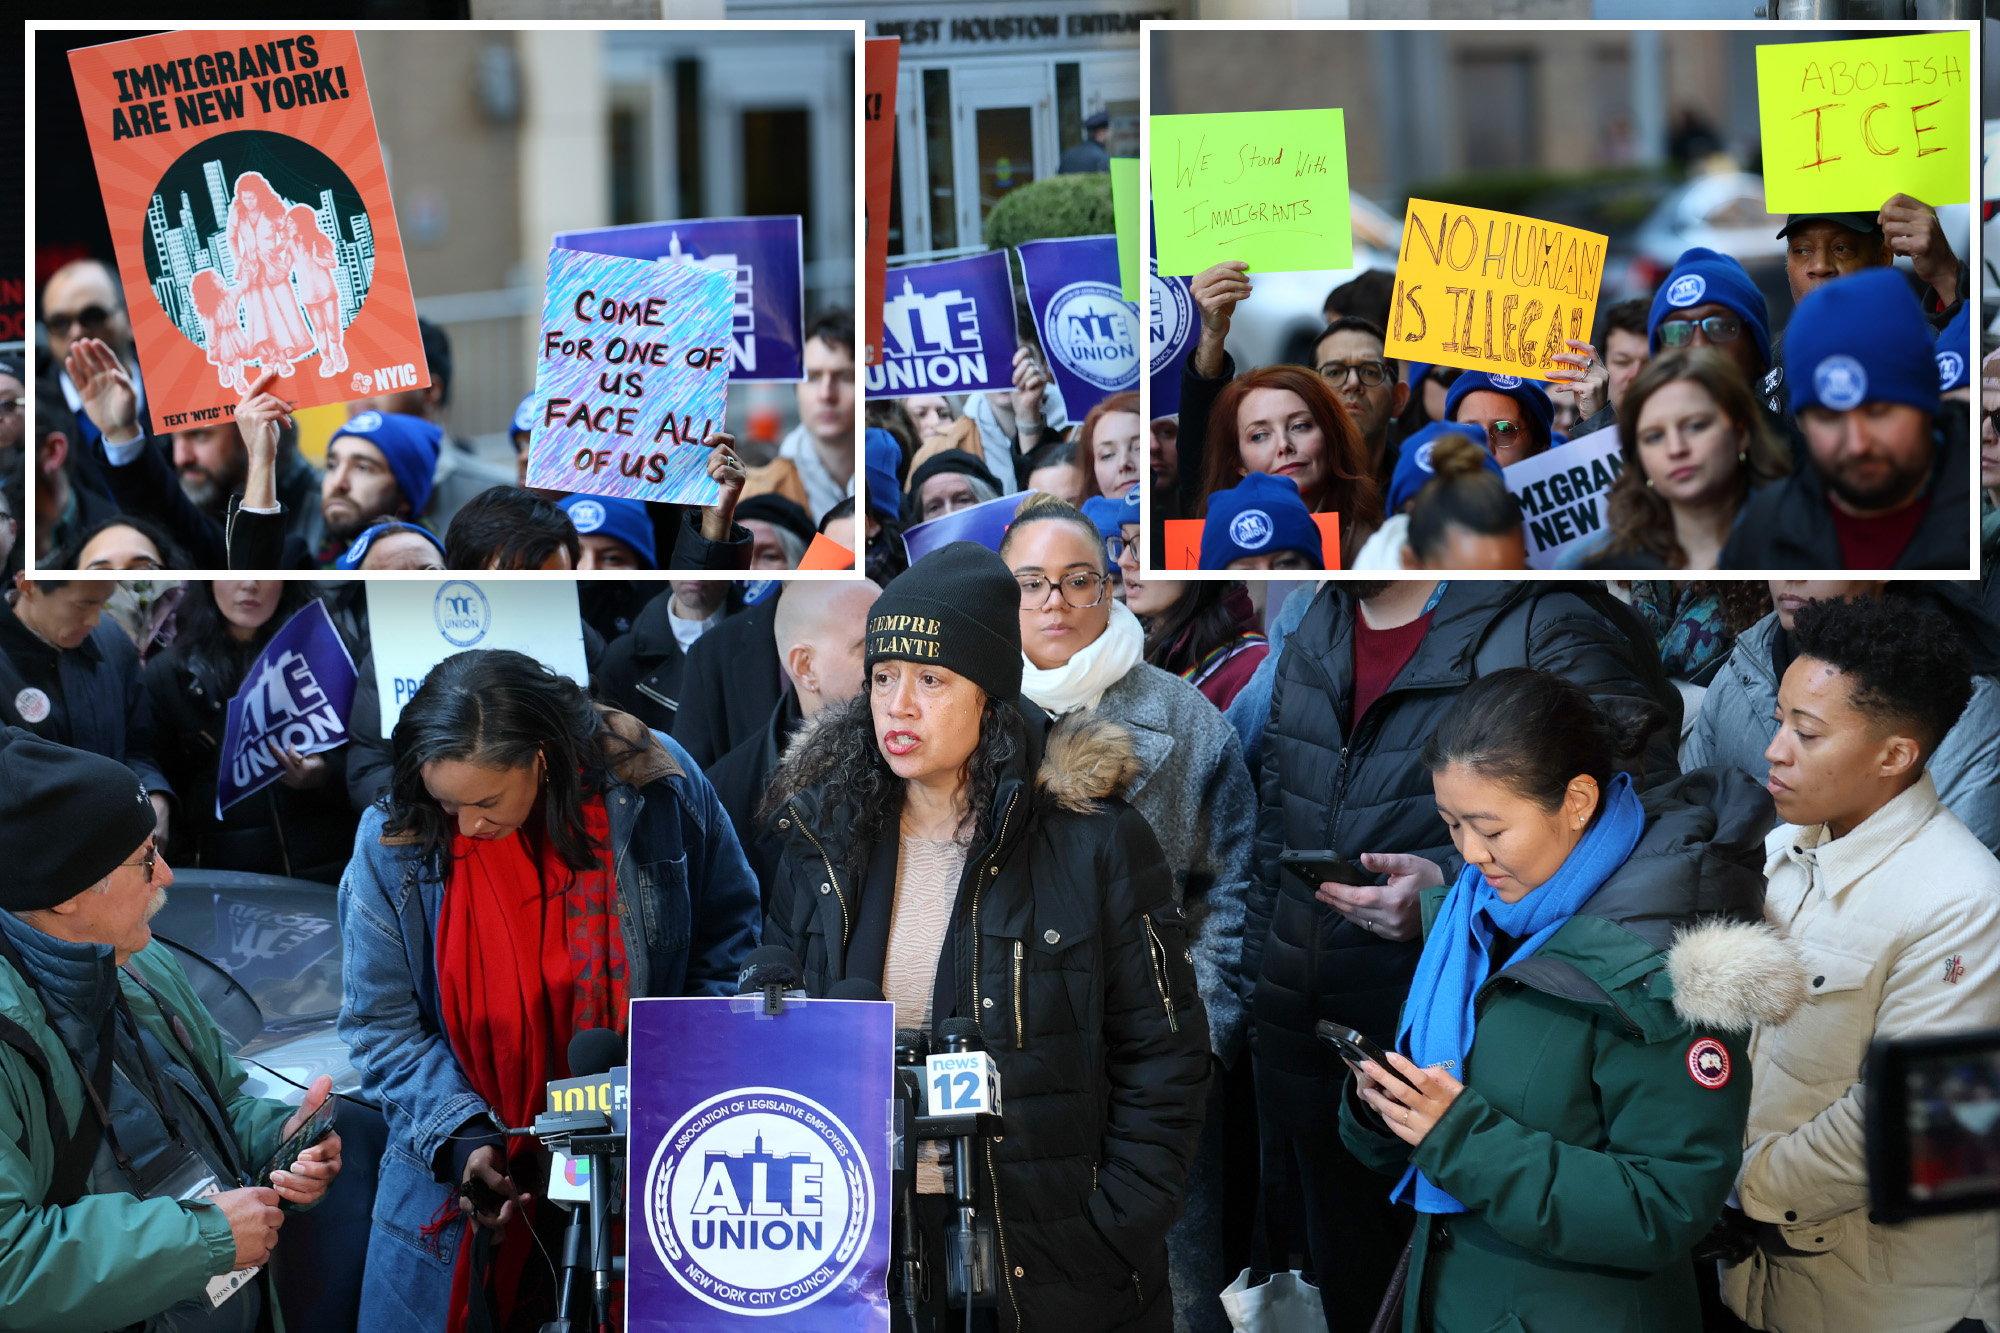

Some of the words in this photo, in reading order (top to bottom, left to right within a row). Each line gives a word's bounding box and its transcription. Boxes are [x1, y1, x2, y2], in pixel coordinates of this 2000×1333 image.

[951, 14, 1059, 42] HOUSTON
[112, 34, 320, 103] IMMIGRANTS
[1801, 55, 1961, 96] ABOLISH
[112, 100, 171, 141] ARE
[174, 85, 244, 129] NEW
[251, 66, 350, 114] YORK!
[1791, 95, 1948, 172] ICE
[1176, 134, 1212, 189] WE
[1223, 143, 1283, 185] Stand
[1295, 150, 1327, 177] With
[1183, 199, 1312, 238] IMMIGRANTS
[1404, 211, 1478, 272] NO
[1481, 220, 1600, 301] HUMAN
[574, 289, 667, 327] COME
[1393, 280, 1427, 342] IS
[544, 330, 595, 362] FOR
[604, 336, 669, 366] ONE
[685, 346, 725, 371] OF
[1068, 315, 1130, 345] ALE
[865, 353, 988, 391] UNION
[1071, 343, 1135, 361] UNION
[374, 363, 418, 391] NYIC
[599, 372, 645, 398] US
[162, 411, 188, 427] TEXT
[190, 406, 221, 422] 'NYIC'
[544, 397, 640, 436] FACE
[653, 411, 718, 448] ALL
[574, 447, 612, 475] OF
[619, 452, 669, 485] US
[1512, 449, 1625, 518] MIGRAN
[1529, 498, 1601, 552] NEW
[445, 619, 480, 629] UNION
[233, 653, 328, 760] ALE
[394, 678, 425, 704] PR
[233, 704, 345, 787] UNION
[933, 1057, 979, 1071] news
[934, 1071, 981, 1110] 12
[675, 1105, 729, 1152] ASSOCIATION
[731, 1100, 745, 1113] OF
[747, 1099, 805, 1119] LEGISLATIVE
[804, 1112, 849, 1157] EMPLOYEES
[690, 1161, 823, 1217] ALE
[691, 1219, 823, 1251] UNION
[685, 1263, 713, 1289] NEW
[712, 1283, 746, 1303] YORK
[749, 1291, 776, 1304] CITY
[779, 1265, 836, 1301] COUNCIL
